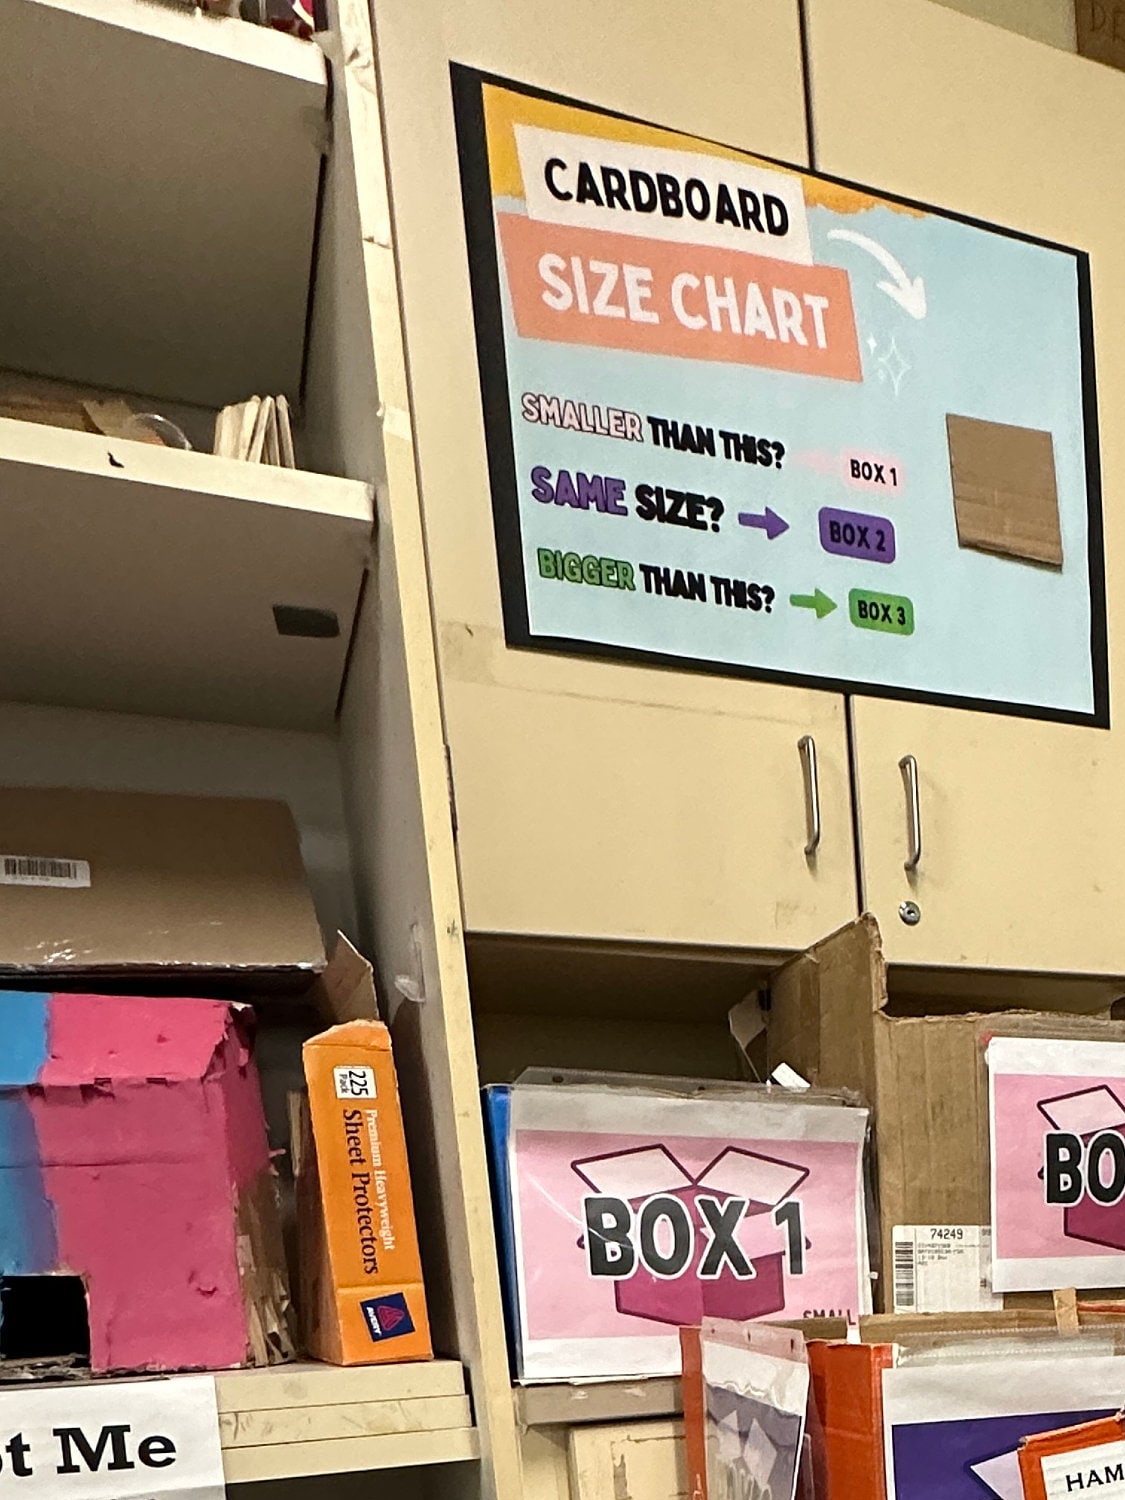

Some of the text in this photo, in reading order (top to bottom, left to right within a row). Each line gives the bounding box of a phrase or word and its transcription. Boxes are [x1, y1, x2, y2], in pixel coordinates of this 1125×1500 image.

[543, 157, 789, 237] CARDBOARD
[540, 253, 830, 349] SIZE CHART
[521, 393, 787, 470] SMALLER THAN THIS?
[530, 466, 726, 533] SAME SIZE?
[850, 459, 898, 487] BOX 1
[828, 520, 887, 553] BOX 2
[536, 547, 775, 614] BIGGER THAN THIS?
[857, 600, 906, 626] BOX 3
[339, 1073, 350, 1094] Pack
[348, 1070, 369, 1096] 225
[343, 1109, 379, 1275] Sheet Protectors
[365, 1109, 396, 1251] Premium Heavyweight
[584, 1196, 803, 1277] BOX 1
[930, 1228, 963, 1240] 74249
[366, 1306, 382, 1336] AVERY
[53, 1424, 177, 1474] Me
